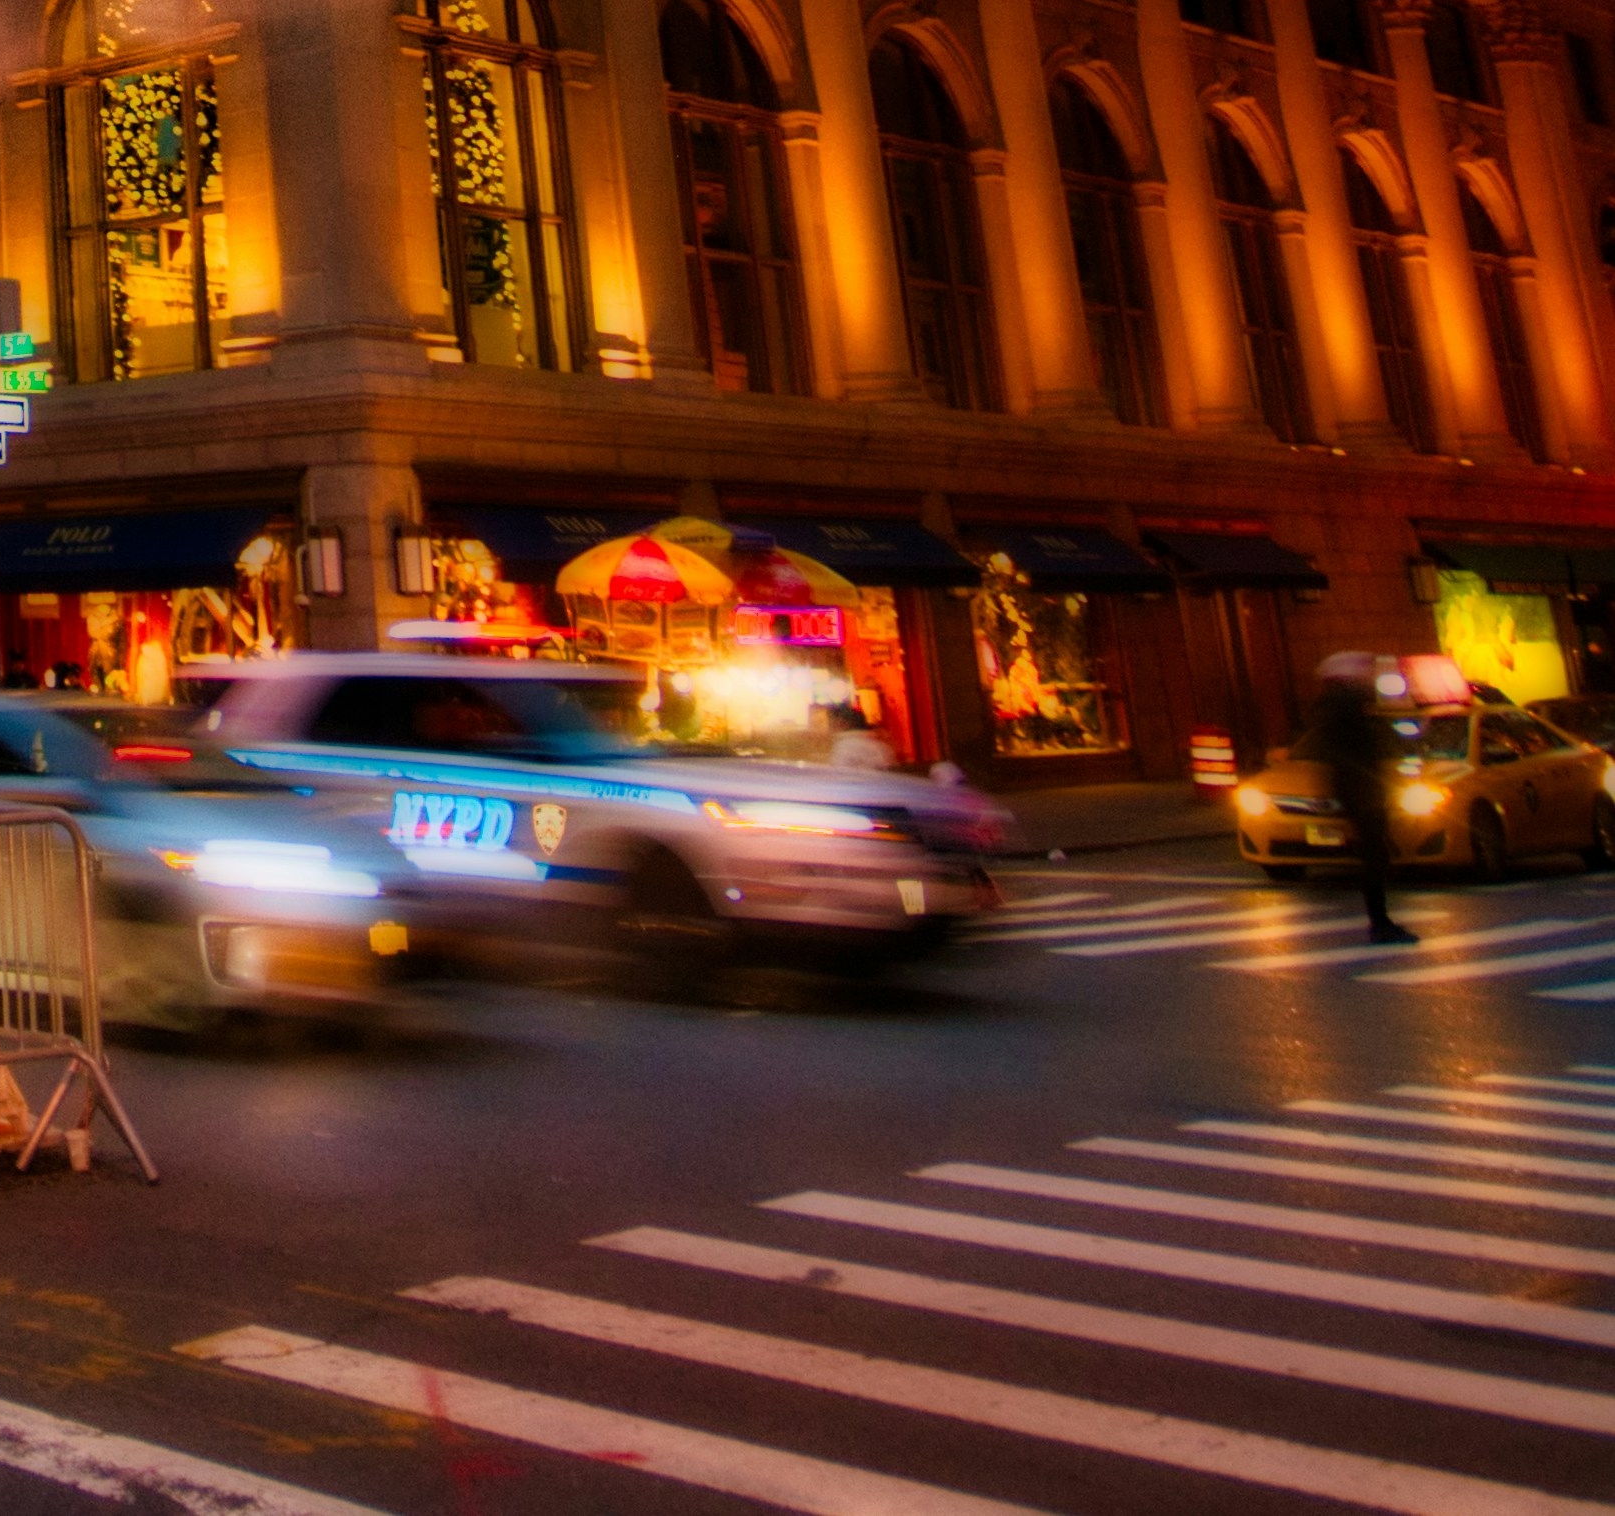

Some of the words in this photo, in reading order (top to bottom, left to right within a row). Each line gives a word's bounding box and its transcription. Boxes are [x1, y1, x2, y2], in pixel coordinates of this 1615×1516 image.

[4, 336, 14, 356] 5
[5, 370, 13, 390] E
[16, 370, 32, 390] 55
[46, 525, 111, 545] POLO
[592, 783, 651, 802] POLICE
[388, 791, 516, 852] NYPD
